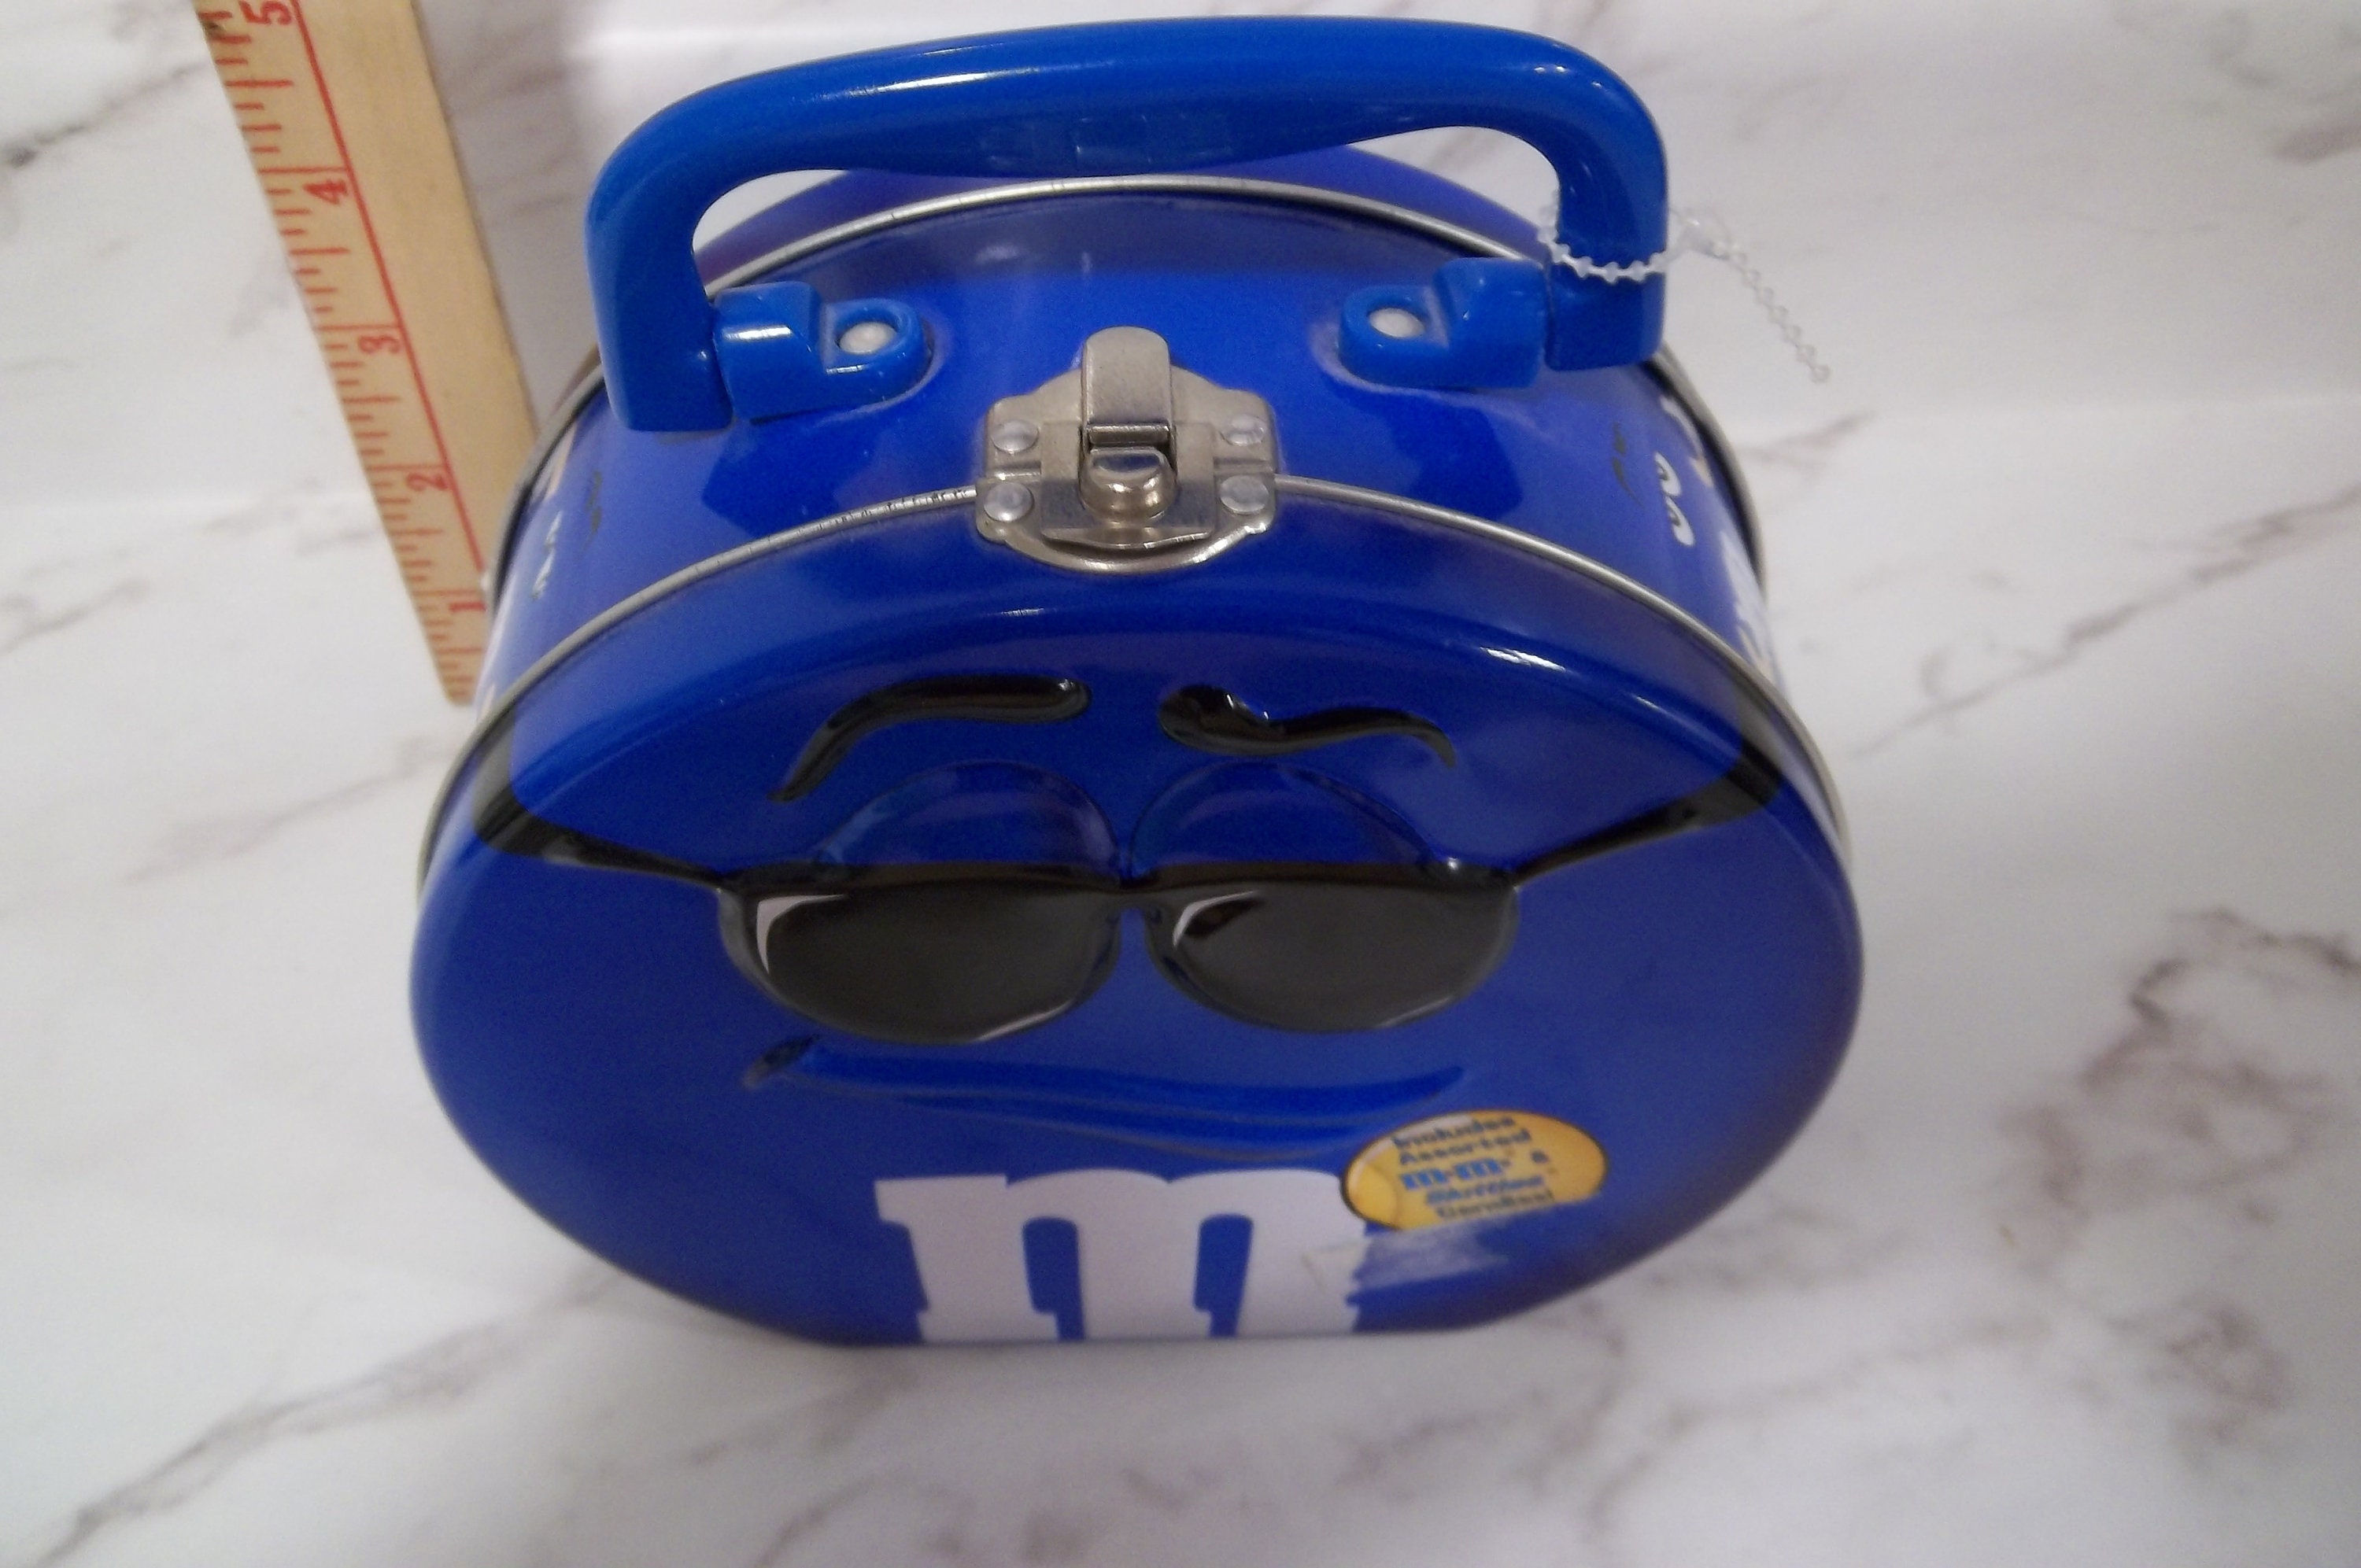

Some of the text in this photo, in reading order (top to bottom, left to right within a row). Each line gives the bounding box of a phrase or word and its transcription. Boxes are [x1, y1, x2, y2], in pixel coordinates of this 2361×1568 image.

[238, 0, 292, 25] 5
[303, 179, 349, 206] 4
[358, 334, 401, 354] 3
[405, 474, 448, 492] 2
[449, 600, 486, 612] 1
[1391, 1116, 1516, 1149] Includes
[1399, 1128, 1532, 1166] Assorted
